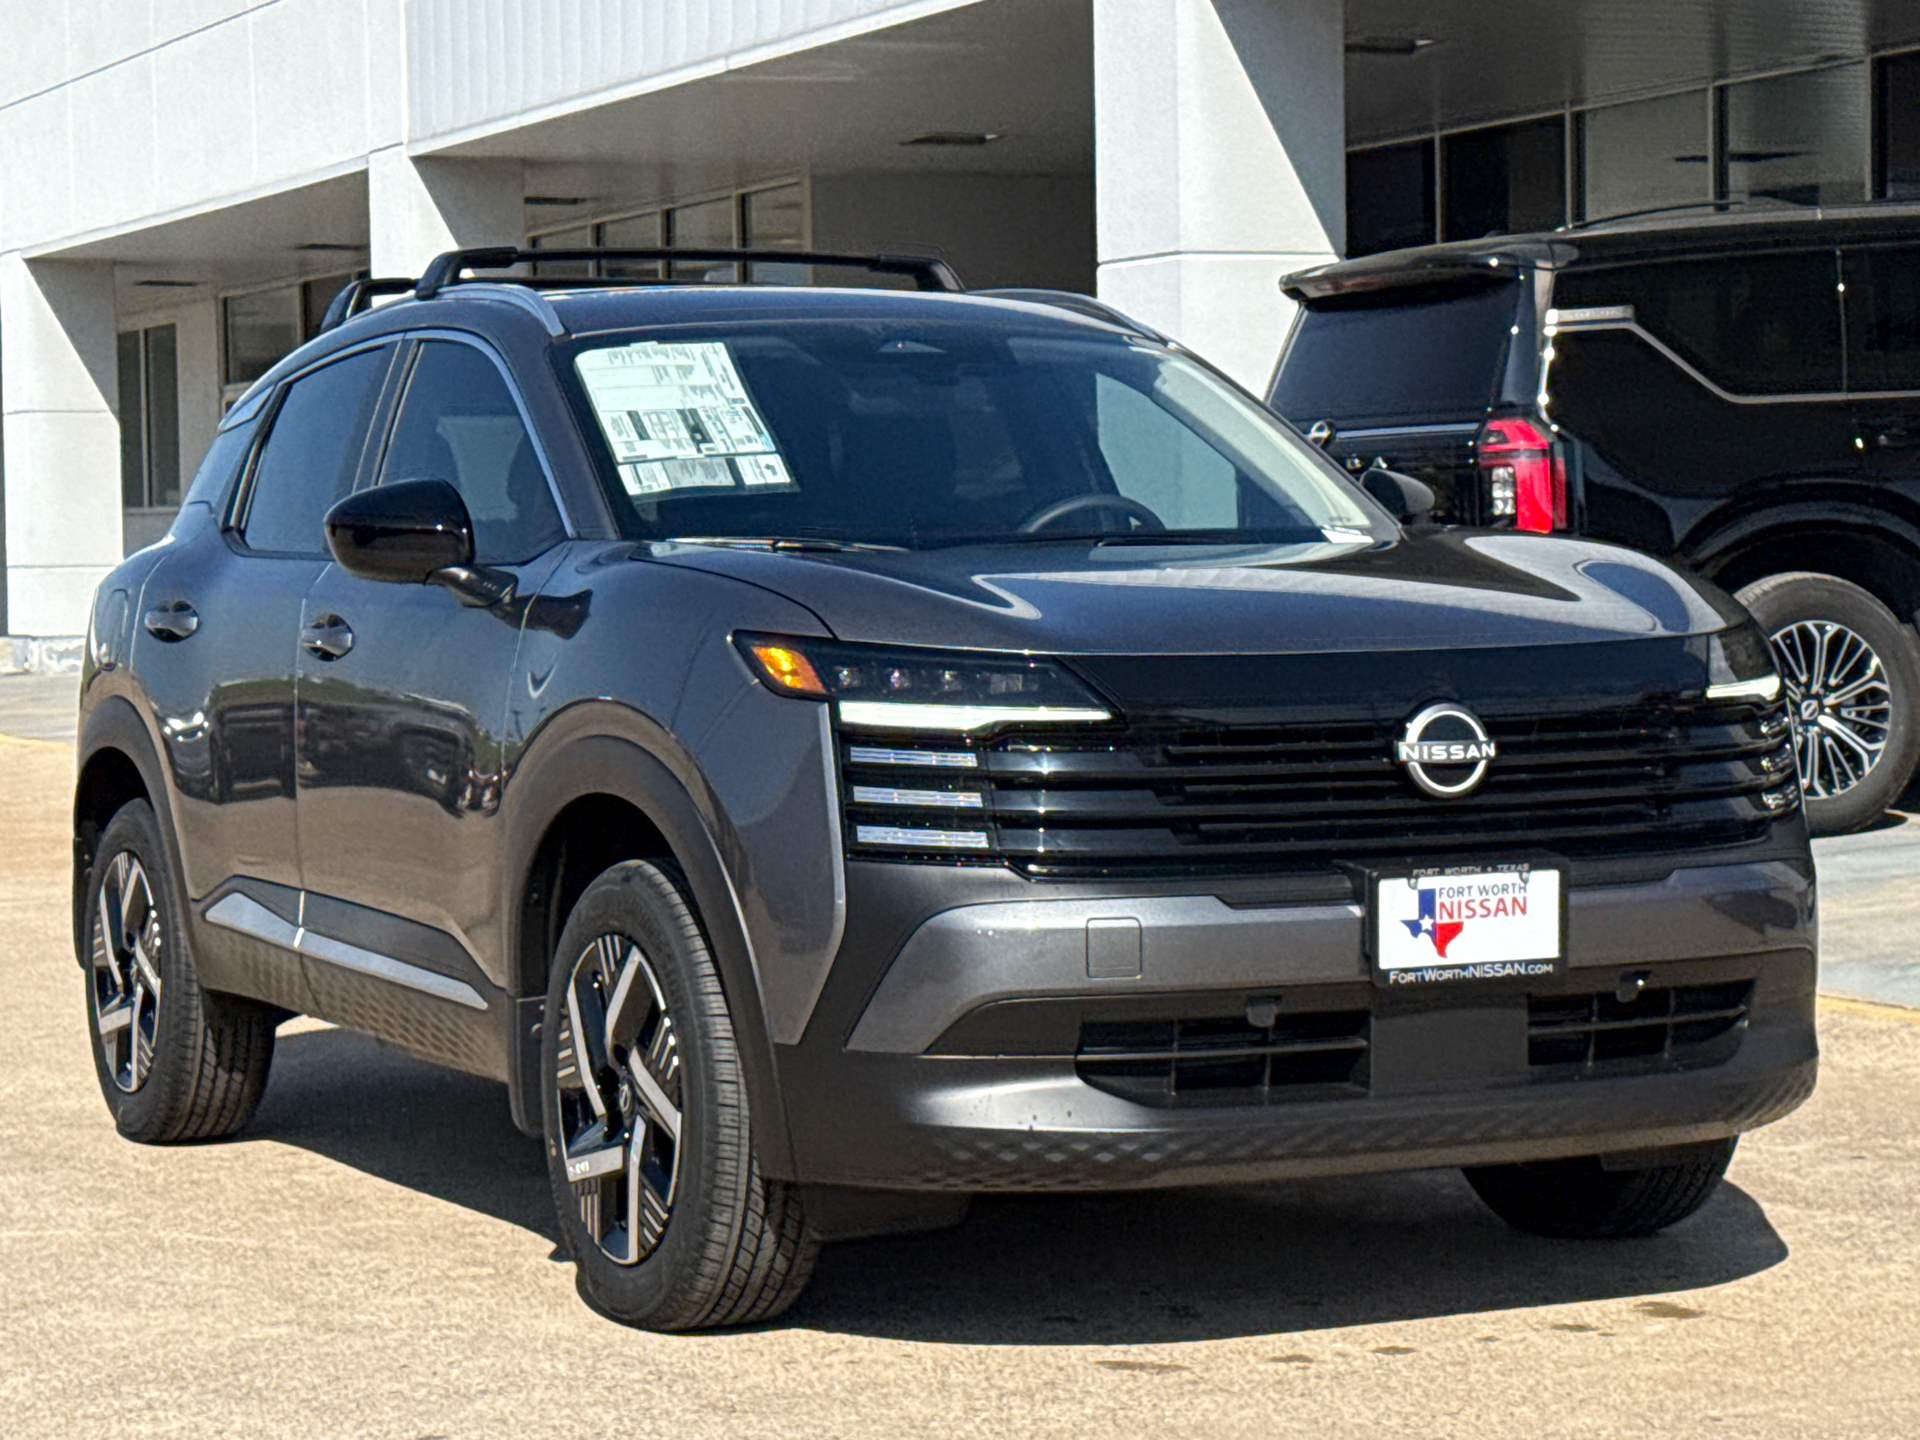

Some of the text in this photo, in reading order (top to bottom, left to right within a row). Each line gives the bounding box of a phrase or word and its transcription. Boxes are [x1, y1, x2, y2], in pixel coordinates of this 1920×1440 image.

[1400, 743, 1496, 761] NISSAN
[1412, 863, 1530, 878] FORT WORTH TEXAS
[1438, 883, 1527, 899] FORT WORTH
[1439, 896, 1528, 920] NISSAN
